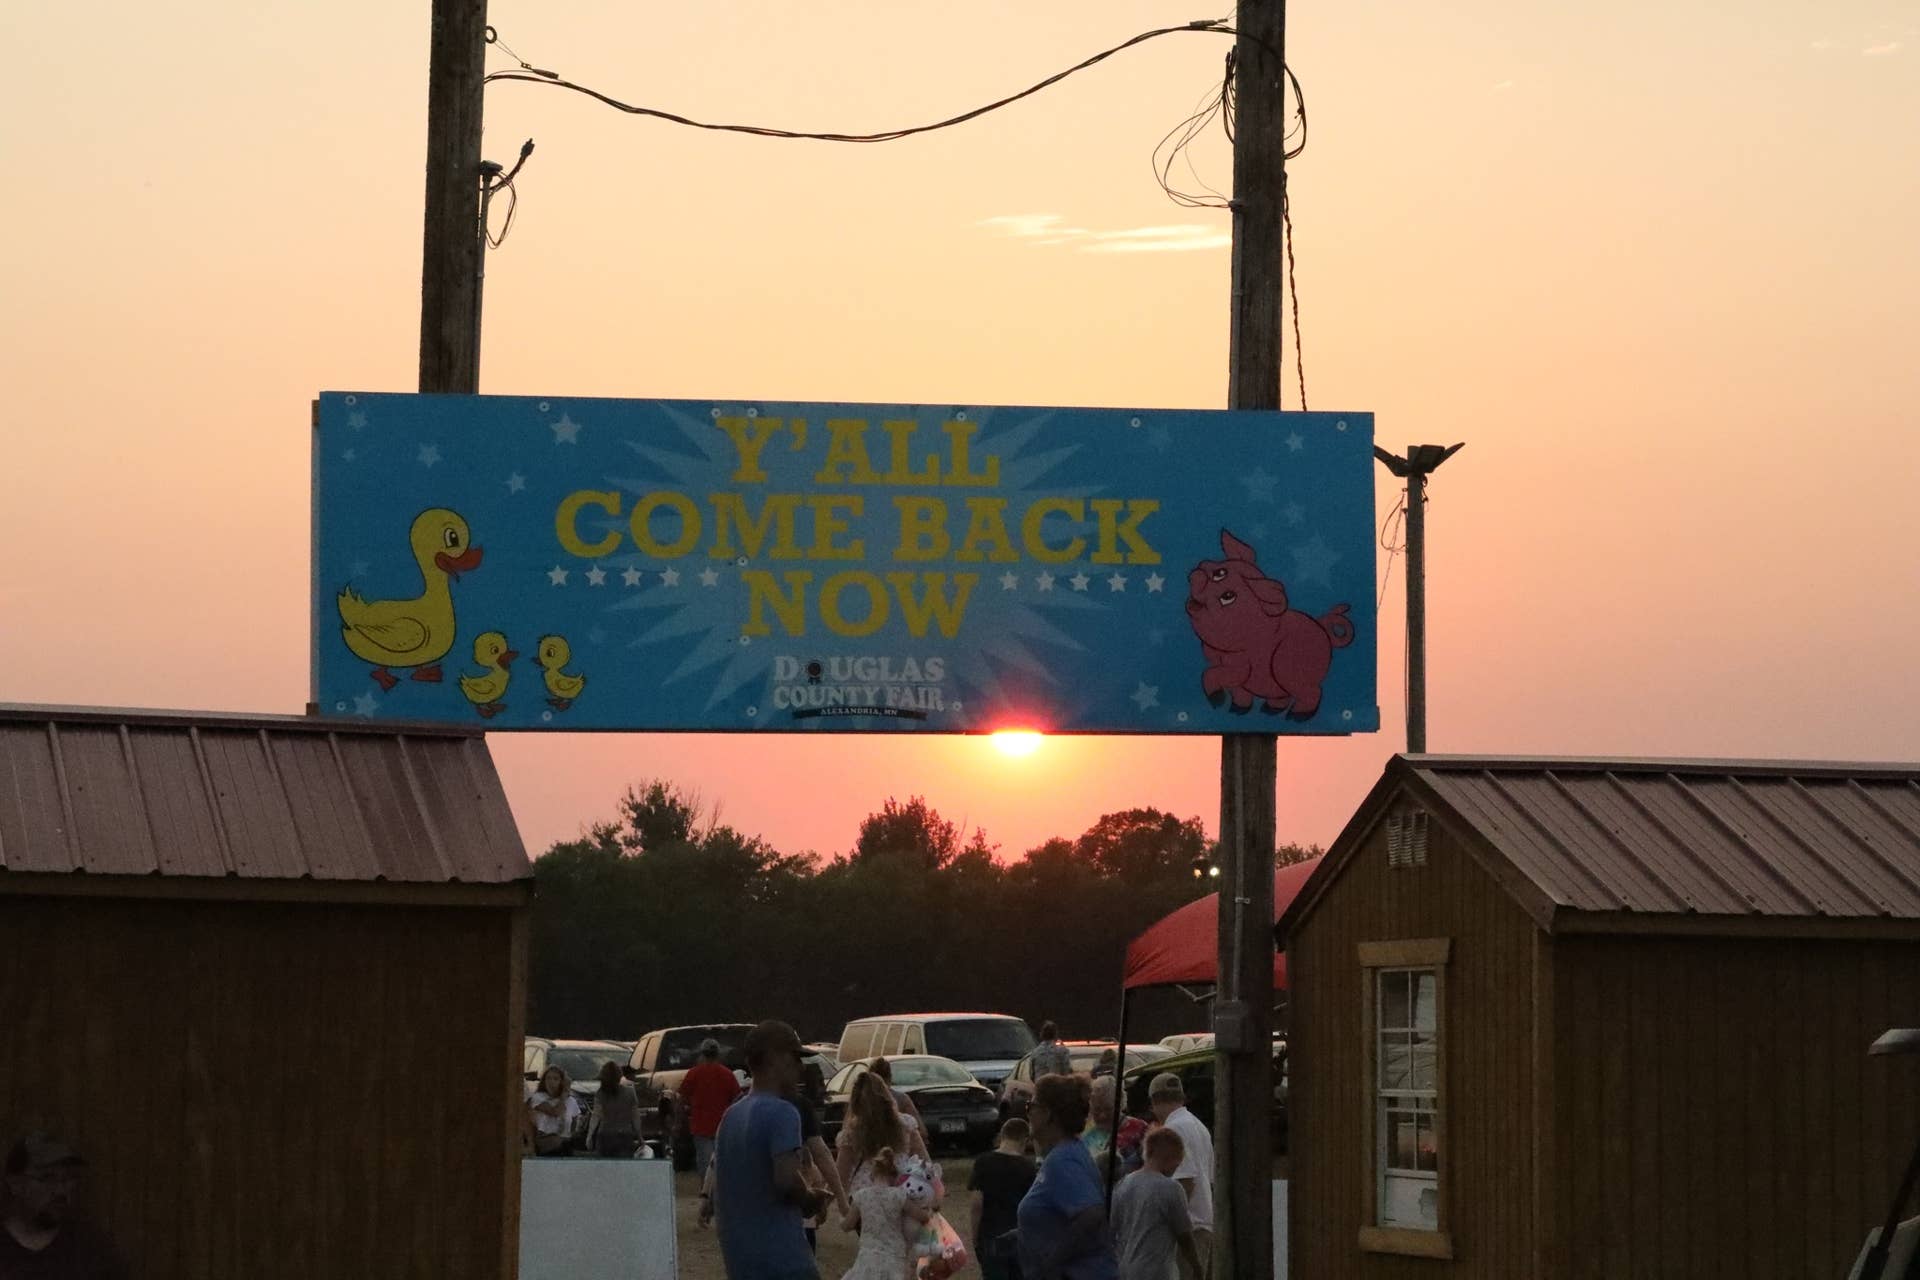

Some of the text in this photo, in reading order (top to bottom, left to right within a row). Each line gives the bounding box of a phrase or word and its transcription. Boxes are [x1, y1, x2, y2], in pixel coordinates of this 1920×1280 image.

[717, 416, 1001, 487] Y'ALL
[556, 490, 1161, 565] COME BACK
[741, 570, 979, 639] NOW
[773, 685, 945, 712] COUNTY FAIR
[883, 708, 898, 716] MN
